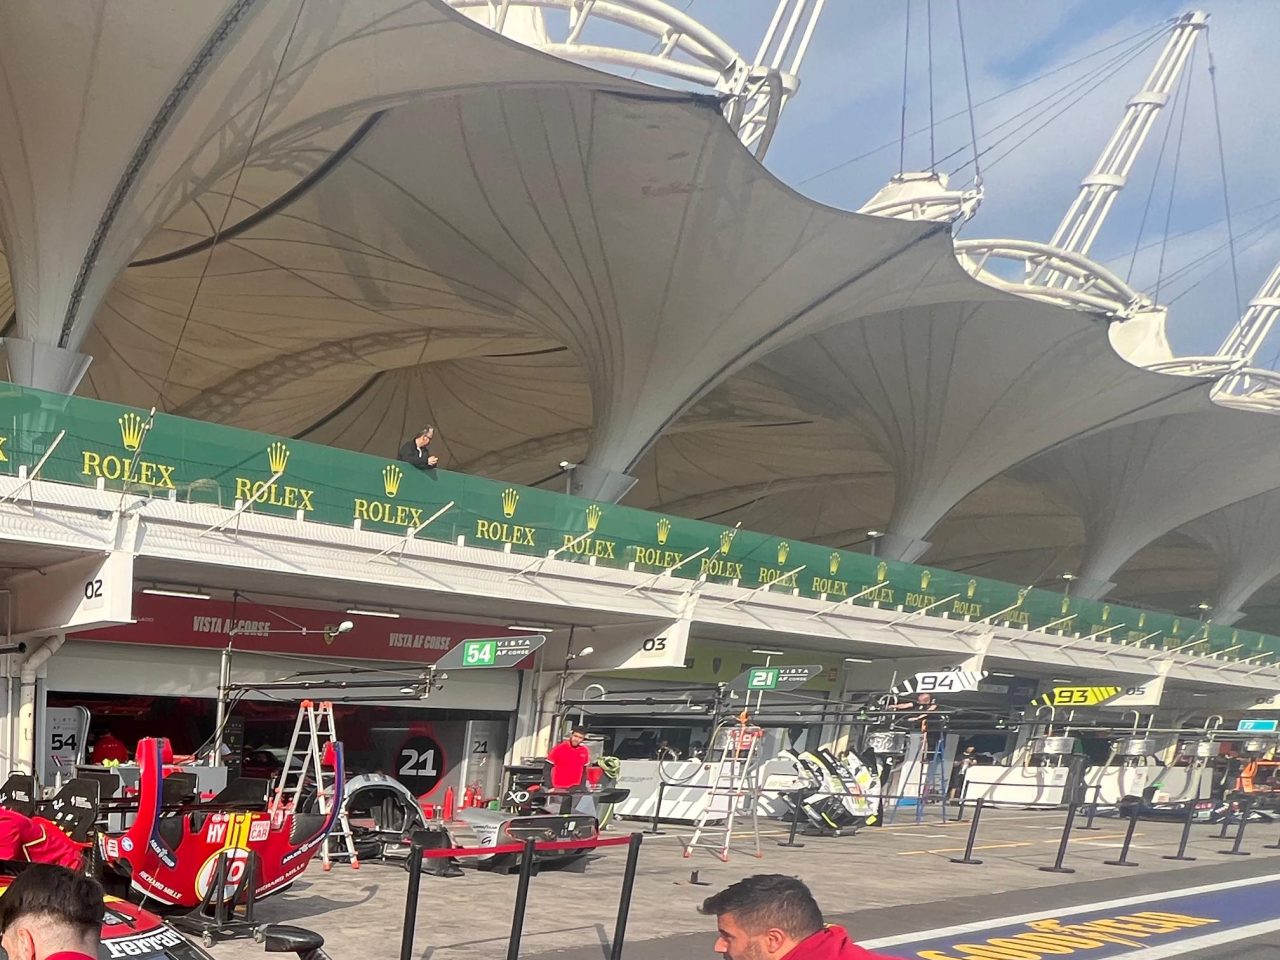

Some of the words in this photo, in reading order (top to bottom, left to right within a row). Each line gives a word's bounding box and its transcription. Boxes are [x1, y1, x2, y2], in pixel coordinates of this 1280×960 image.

[82, 451, 175, 489] ROLEX
[235, 477, 315, 512] ROLEX
[354, 498, 424, 528] ROLEX
[476, 520, 536, 547] ROLEX
[563, 535, 615, 559] ROLEX
[635, 546, 683, 570] ROLEX
[700, 557, 744, 579] ROLEX
[758, 567, 799, 588] ROLEX
[84, 578, 103, 600] 02
[812, 578, 848, 596] ROLEX
[860, 584, 895, 603] ROLEX
[905, 592, 936, 610] ROLEX
[953, 600, 982, 616] ROLEX
[193, 615, 221, 633] VISTA
[237, 620, 271, 637] CORSE
[389, 632, 412, 648] VISTA
[413, 634, 424, 648] AF
[424, 635, 451, 650] CORSE
[497, 639, 531, 647] VISTA
[642, 637, 666, 651] 03
[467, 643, 491, 663] 54
[752, 671, 773, 686] 21
[921, 675, 954, 691] 94
[1057, 689, 1089, 704] 93
[1126, 687, 1147, 695] 05
[51, 733, 77, 751] 54
[473, 740, 488, 754] 21
[399, 749, 437, 776] 21
[506, 790, 530, 803] XO
[206, 823, 225, 843] HY
[250, 828, 268, 840] CAR
[252, 821, 269, 829] HYPER
[285, 862, 305, 879] MILLE
[163, 885, 183, 899] MILLE
